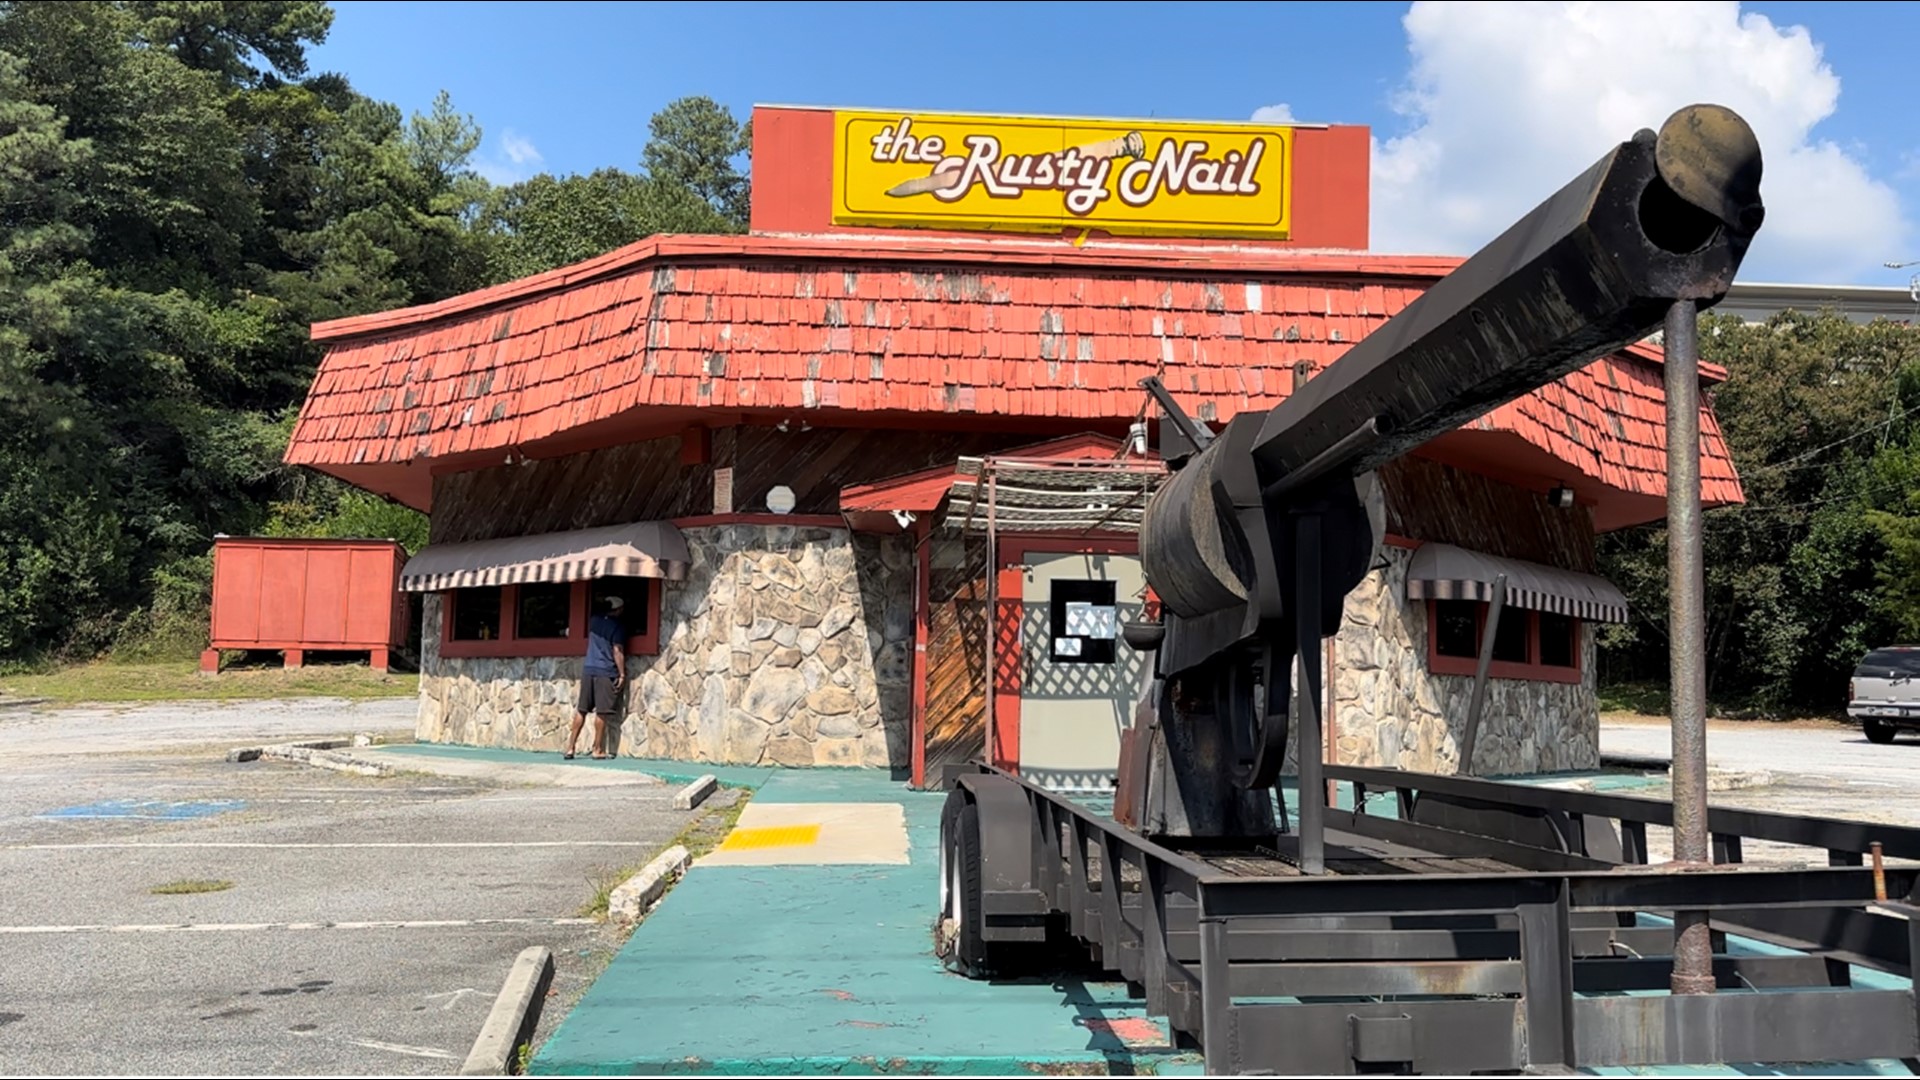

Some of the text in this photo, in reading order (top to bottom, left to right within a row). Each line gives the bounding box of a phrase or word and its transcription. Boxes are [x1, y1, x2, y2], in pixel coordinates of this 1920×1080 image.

[871, 118, 1265, 213] the Rusty Nail
